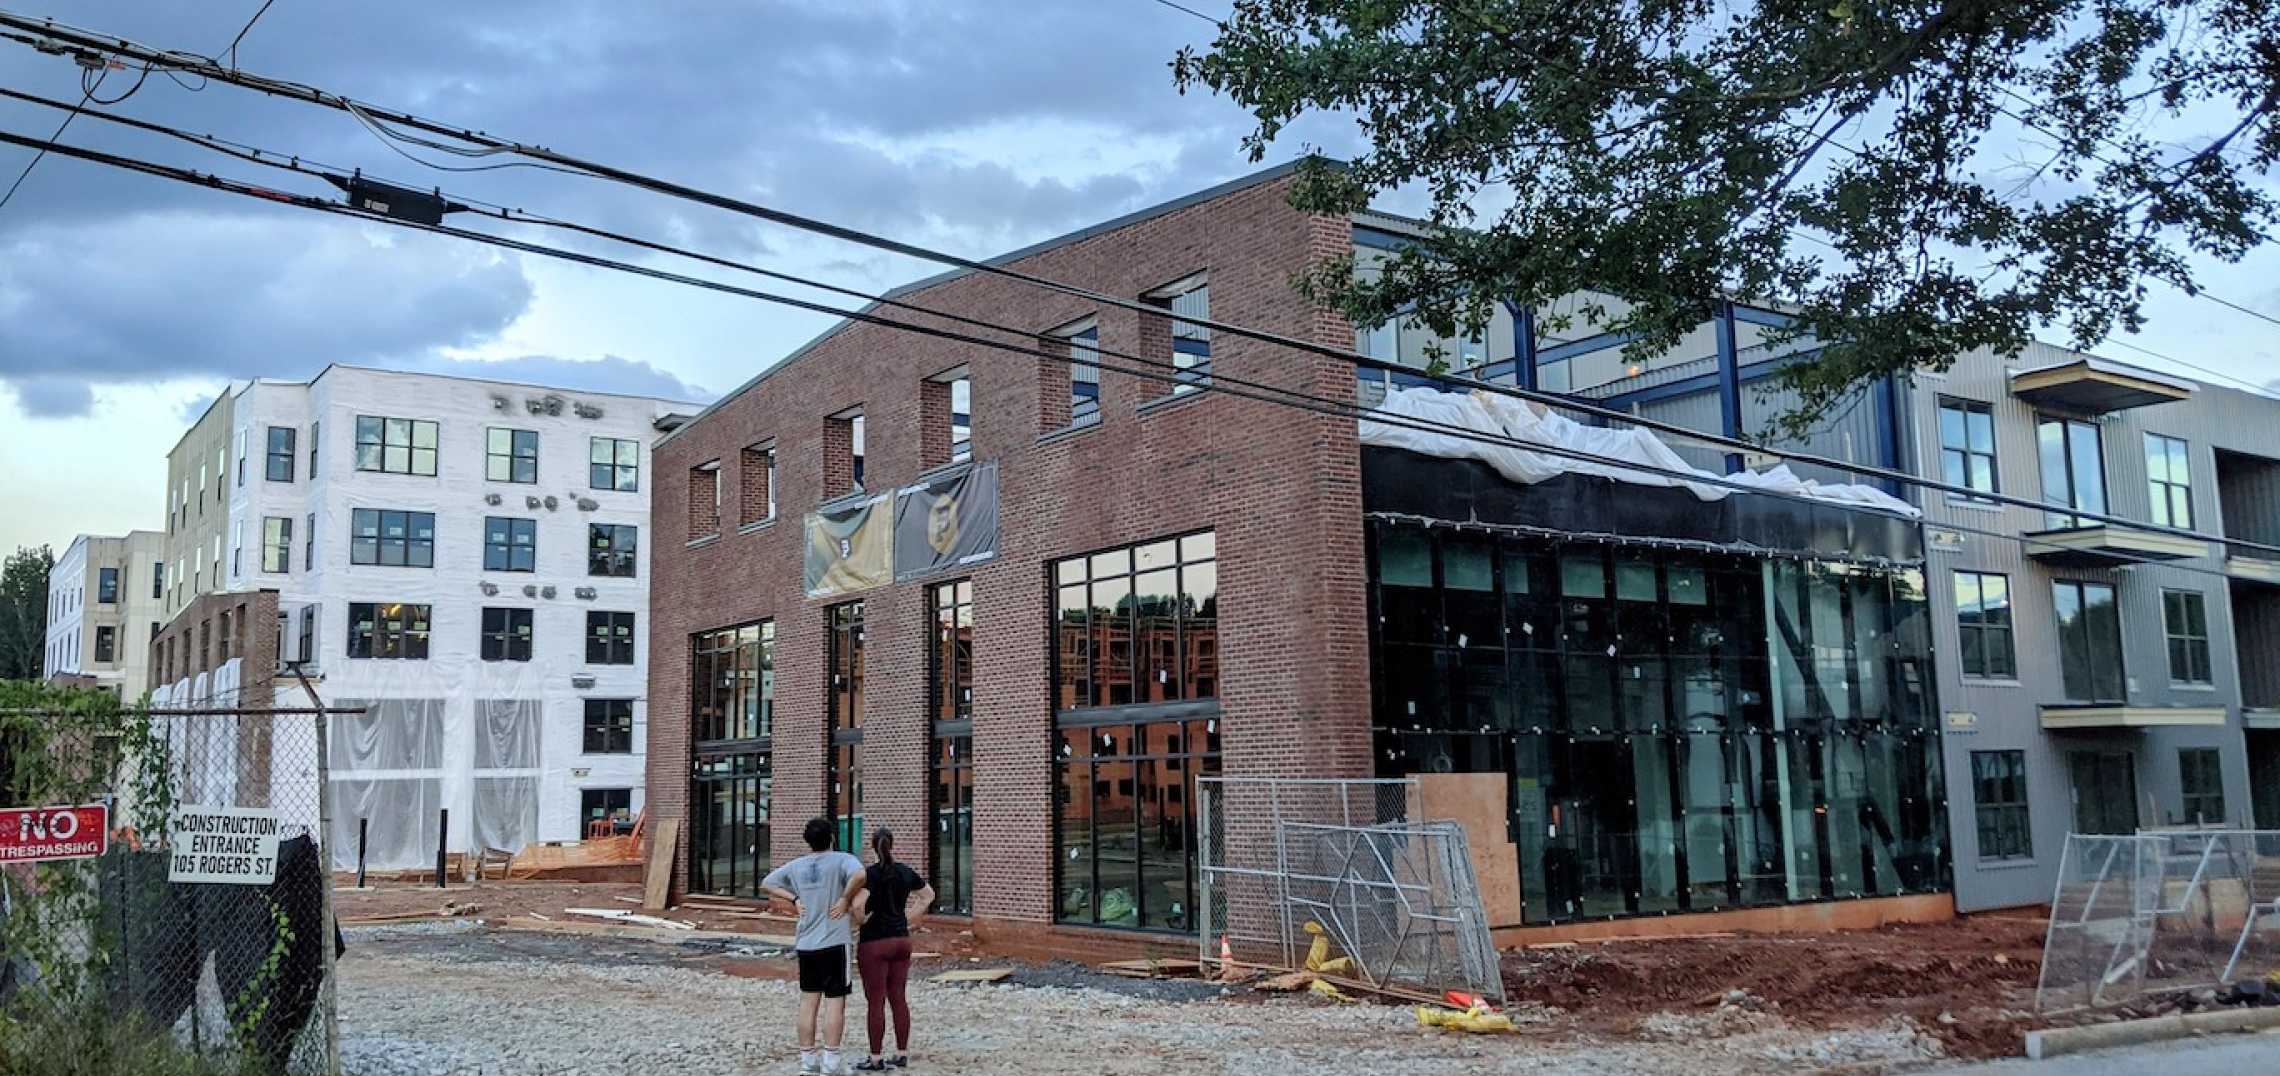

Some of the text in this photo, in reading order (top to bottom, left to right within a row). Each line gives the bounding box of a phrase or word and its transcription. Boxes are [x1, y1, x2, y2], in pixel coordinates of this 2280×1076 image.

[20, 811, 79, 842] NO
[180, 814, 278, 836] CONSTRUCTION
[0, 841, 98, 858] TRESPASSING
[192, 834, 261, 855] ENTRANCE
[174, 854, 273, 876] 105 ROGERS ST.
